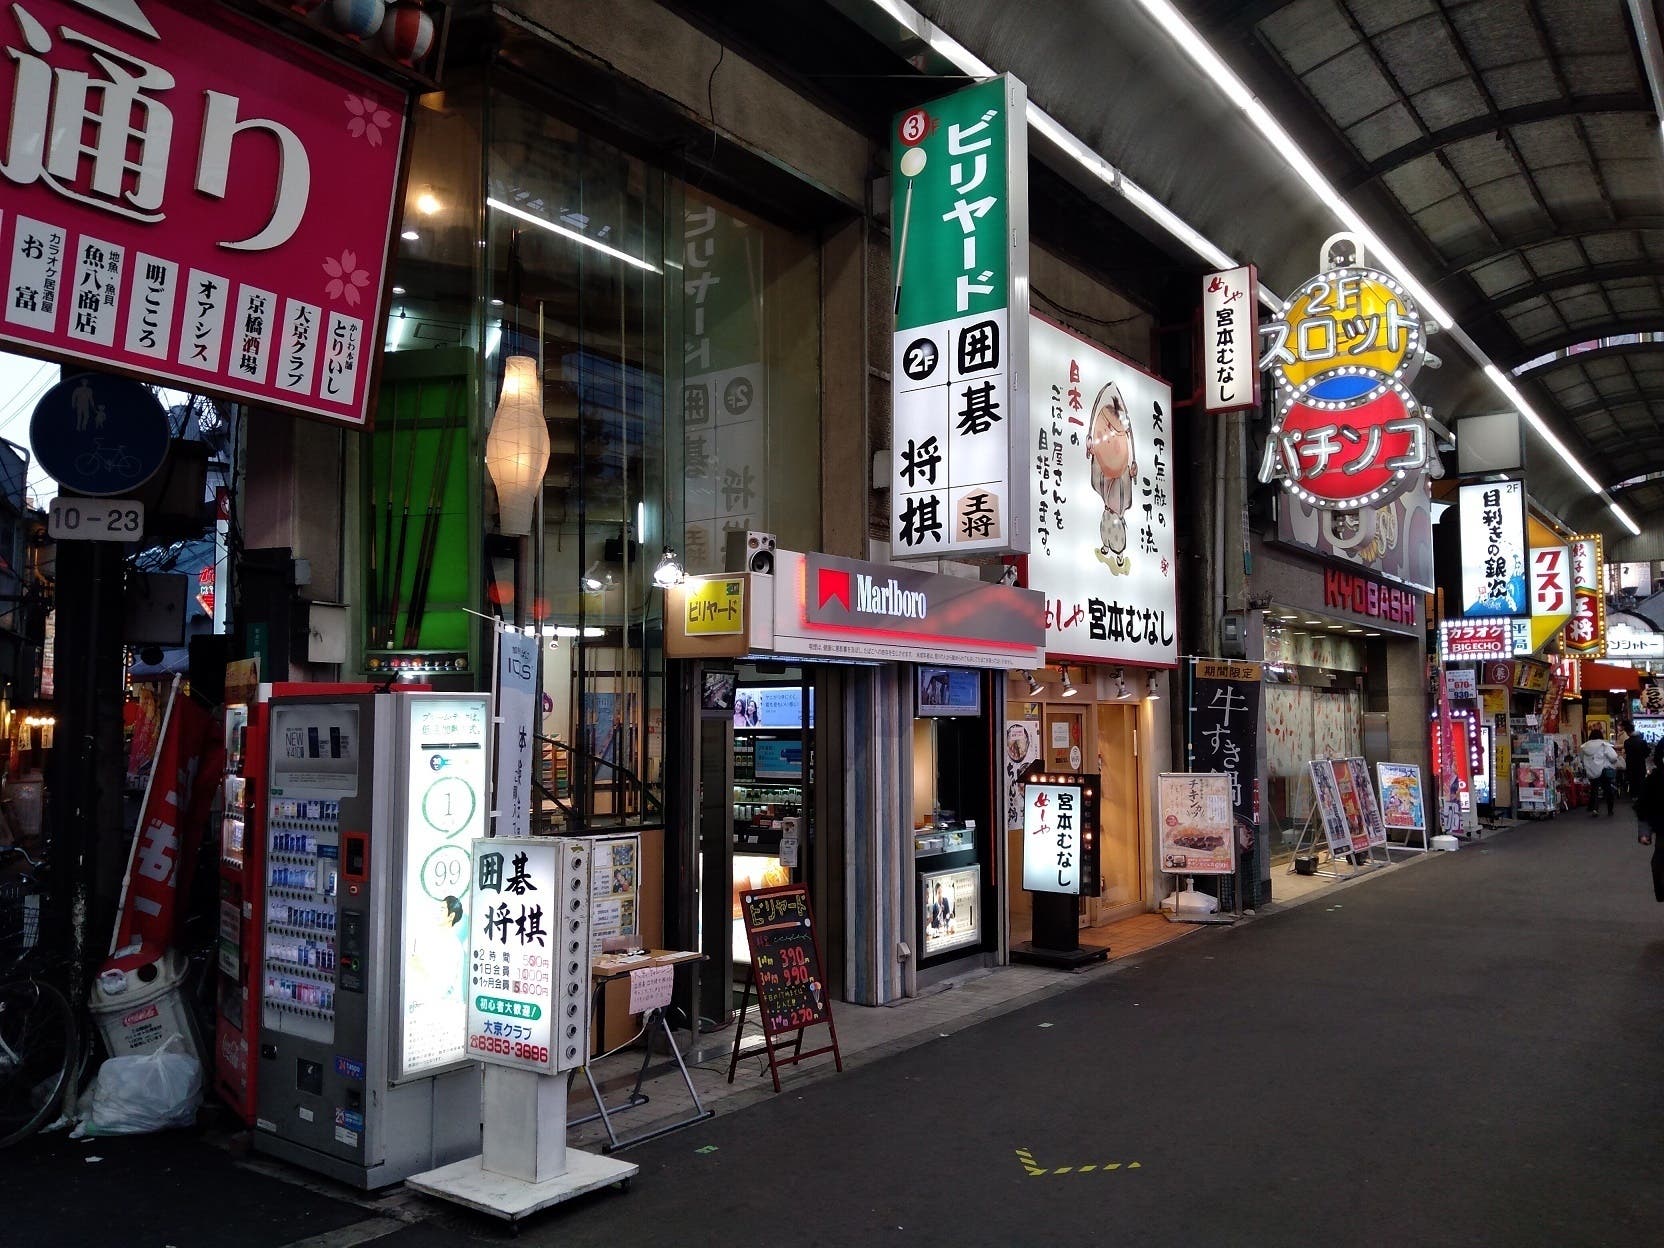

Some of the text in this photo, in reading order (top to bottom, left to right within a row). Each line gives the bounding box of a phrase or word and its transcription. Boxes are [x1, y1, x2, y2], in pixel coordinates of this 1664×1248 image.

[0, 3, 310, 251] 通り
[942, 109, 998, 312] ビリヤード
[41, 232, 62, 314] カラオケ居酒屋
[75, 244, 105, 336] 魚八商店
[1207, 276, 1244, 304] めしや
[1306, 274, 1362, 313] 2F
[138, 263, 166, 349] 明ごころ
[192, 279, 219, 362] オアシス
[239, 294, 266, 376] 京橋酒場
[1259, 300, 1420, 371] スロット
[287, 305, 313, 387] 大京クラブ
[327, 319, 348, 395] とりいし
[908, 348, 935, 374] 2F
[1216, 308, 1235, 402] 宮本むなし
[956, 320, 1003, 436] 囲碁
[1258, 418, 1428, 484] パチンコ
[899, 435, 942, 547] 将棋
[961, 493, 996, 538] 王将
[1506, 484, 1520, 494] 2F
[1482, 488, 1508, 598] 目利きの銀次
[856, 573, 928, 620] Marlboro
[1324, 567, 1417, 626] KYOBASHI
[1536, 550, 1564, 611] クスリ
[689, 599, 738, 622] ビリヤード
[1088, 597, 1174, 647] 宮本むなし
[1449, 625, 1504, 639] カラオケ
[1570, 596, 1594, 641] 王将
[1203, 664, 1254, 679] 期間限定
[1452, 641, 1502, 652] BIG ECHO
[1033, 792, 1051, 835] めしや
[1057, 793, 1074, 887] 宮本むなし
[479, 851, 538, 895] 囲碁
[483, 901, 547, 947] 将棋
[480, 963, 510, 977] 1日会員
[483, 1019, 533, 1041] 大京クラブ
